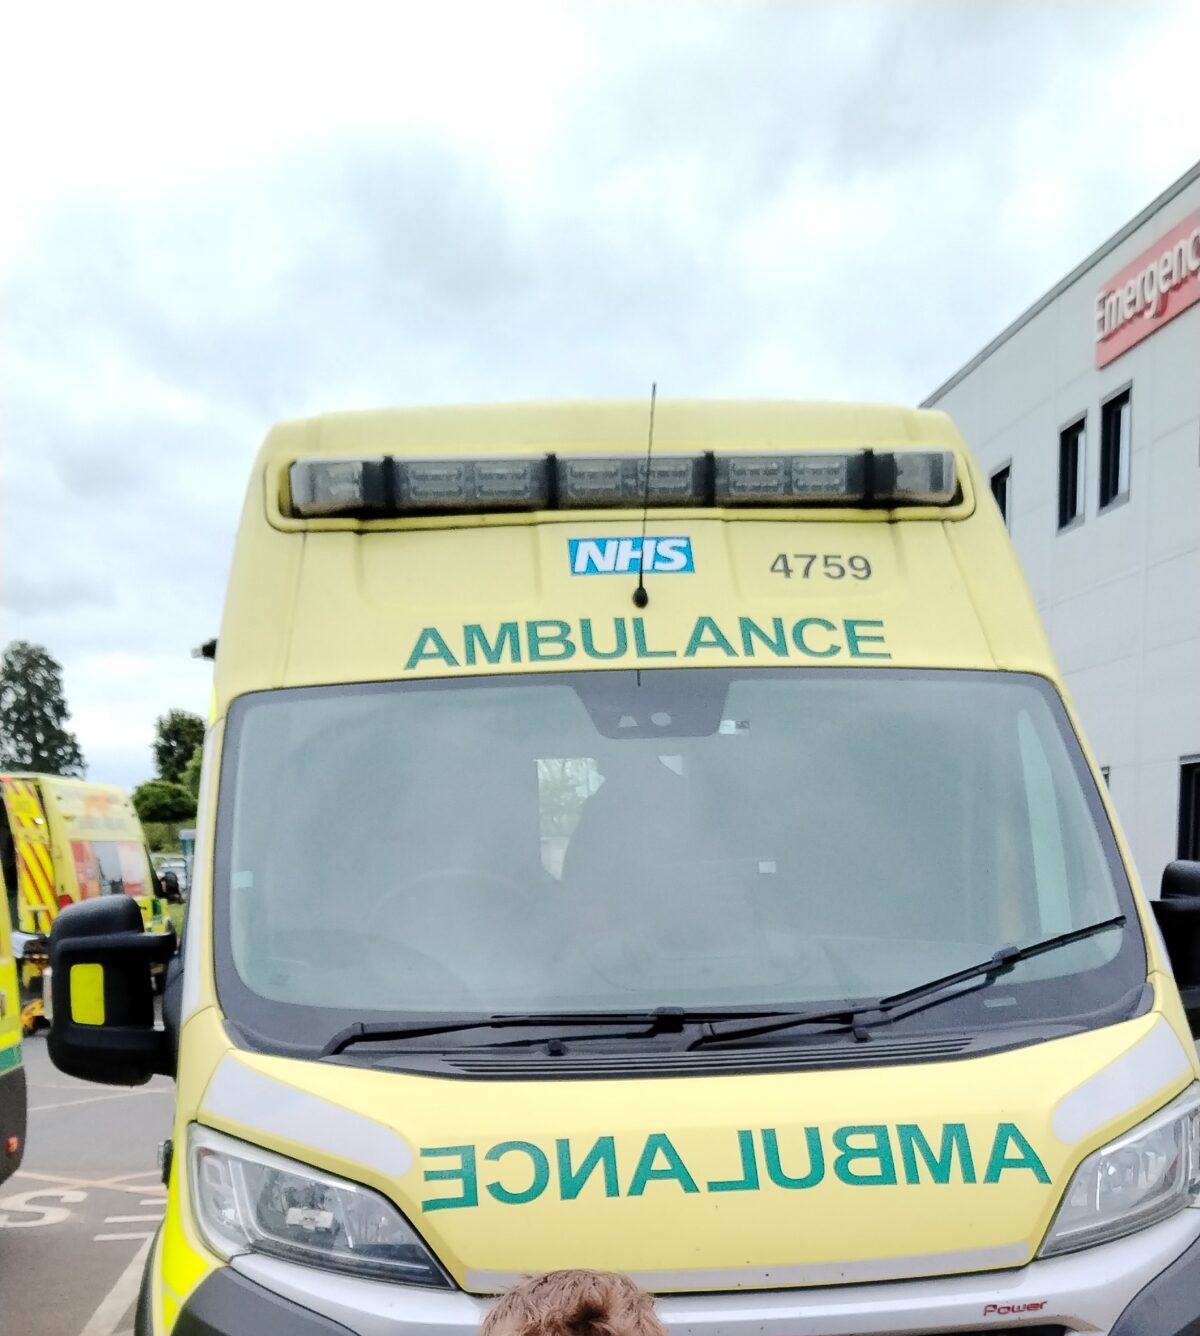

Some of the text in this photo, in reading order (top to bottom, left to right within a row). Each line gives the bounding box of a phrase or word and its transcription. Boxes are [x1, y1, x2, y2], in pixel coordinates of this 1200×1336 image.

[1095, 225, 1200, 342] Emergenc
[574, 539, 688, 572] NHS
[769, 553, 872, 580] 4759
[404, 617, 892, 670] AMBULANCE
